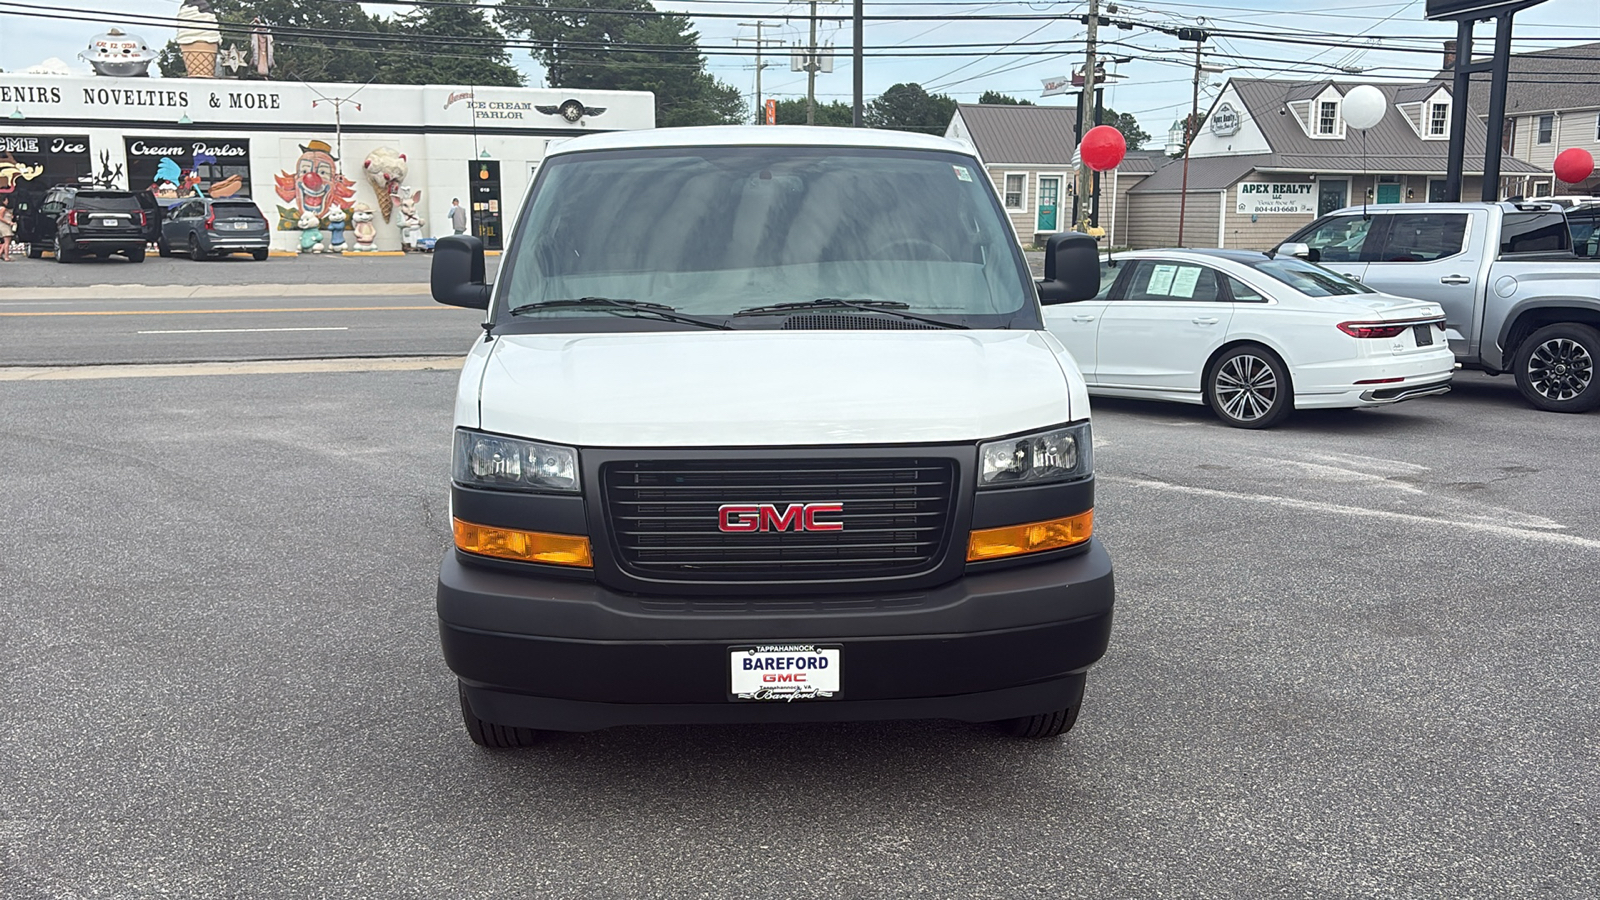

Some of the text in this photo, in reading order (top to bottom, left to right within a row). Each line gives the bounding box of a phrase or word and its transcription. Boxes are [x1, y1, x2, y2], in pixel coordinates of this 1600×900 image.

[0, 87, 281, 109] ENIRS NOVELTIES & MORE
[466, 101, 532, 110] ICE CREAM
[475, 110, 523, 119] PARLOR
[50, 138, 86, 153] Ice
[130, 140, 247, 157] Cream Parlor
[1242, 184, 1312, 194] APEX REALTY
[718, 502, 844, 533] GMC
[756, 645, 815, 653] TAPPAHANNOCK
[742, 656, 829, 671] BAREFORD
[762, 673, 808, 683] GMC
[753, 688, 818, 702] Bareford
